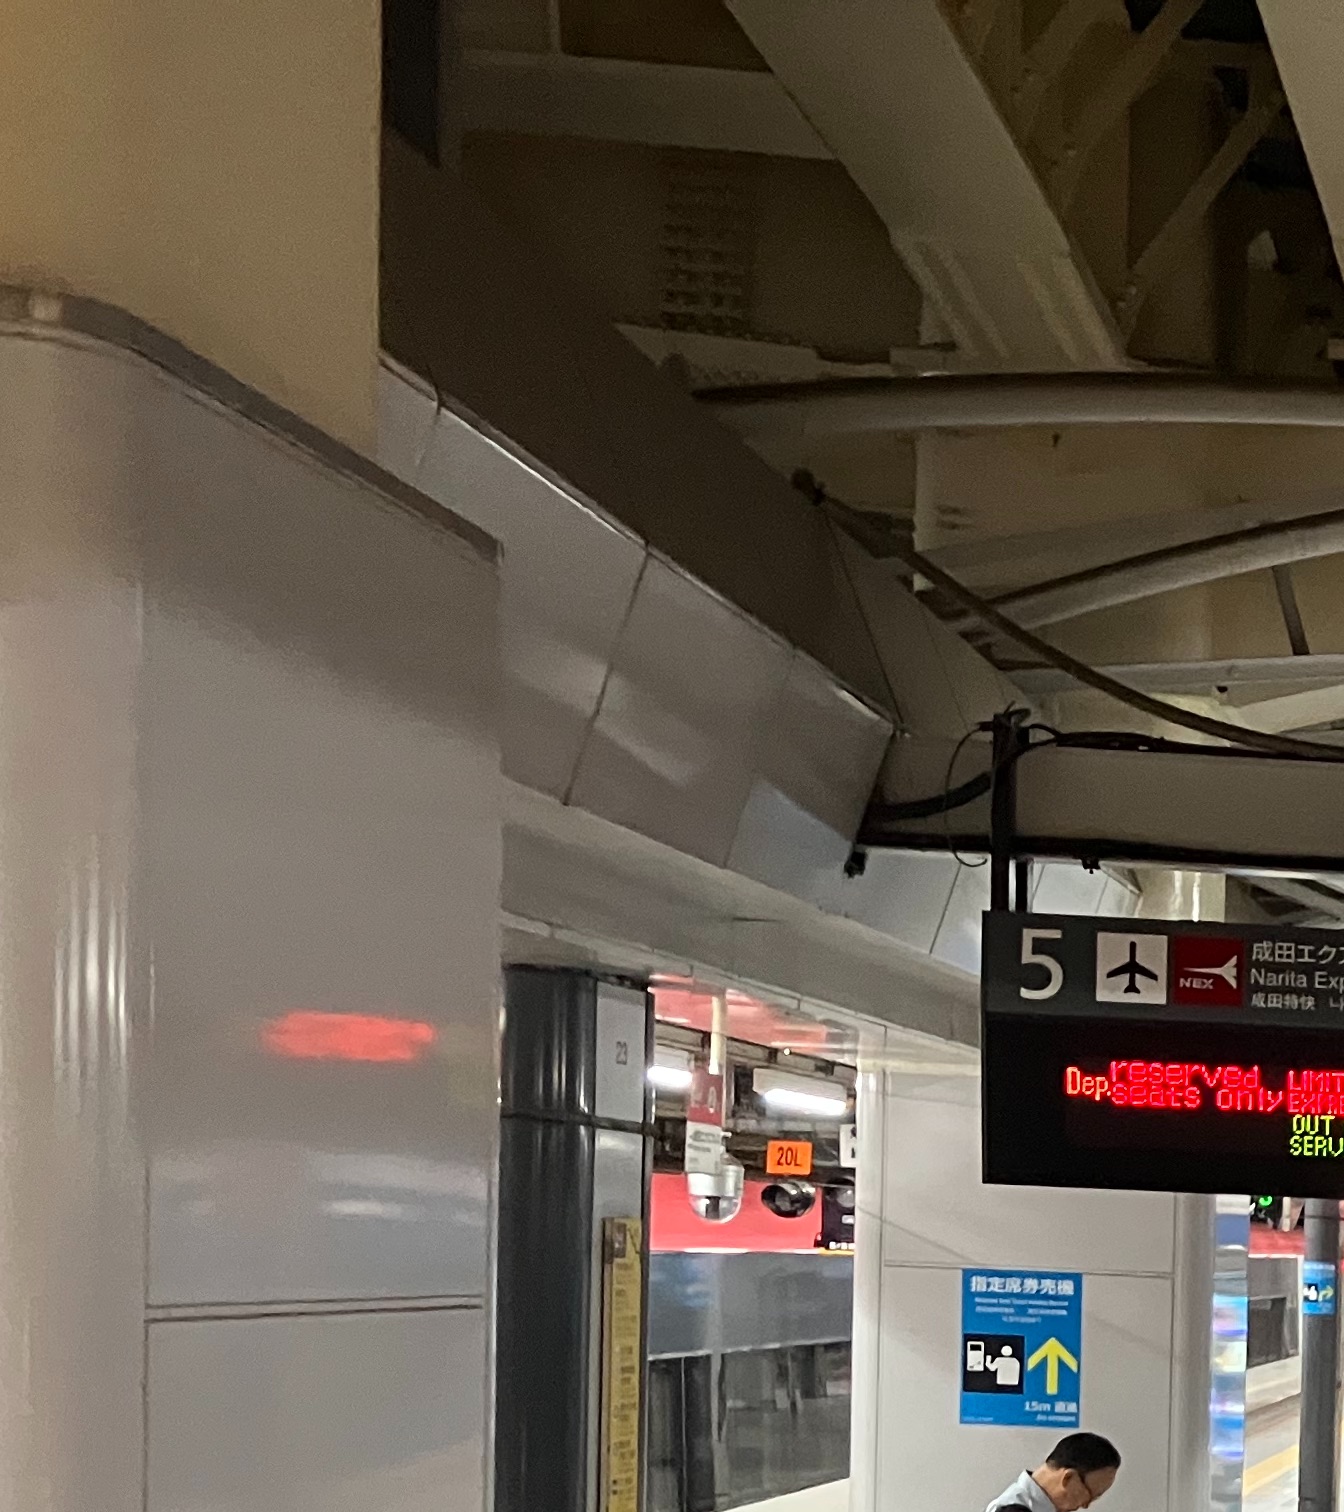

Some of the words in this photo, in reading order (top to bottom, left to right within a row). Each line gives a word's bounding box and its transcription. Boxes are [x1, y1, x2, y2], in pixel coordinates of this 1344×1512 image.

[1018, 927, 1064, 1000] 5
[1251, 967, 1308, 989] Narita
[1066, 1066, 1112, 1102] Dep.
[1110, 1060, 1259, 1089] reserved
[1110, 1084, 1201, 1107] seats
[1216, 1087, 1283, 1113] only
[1292, 1116, 1330, 1136] OUT
[776, 1145, 802, 1167] 20L
